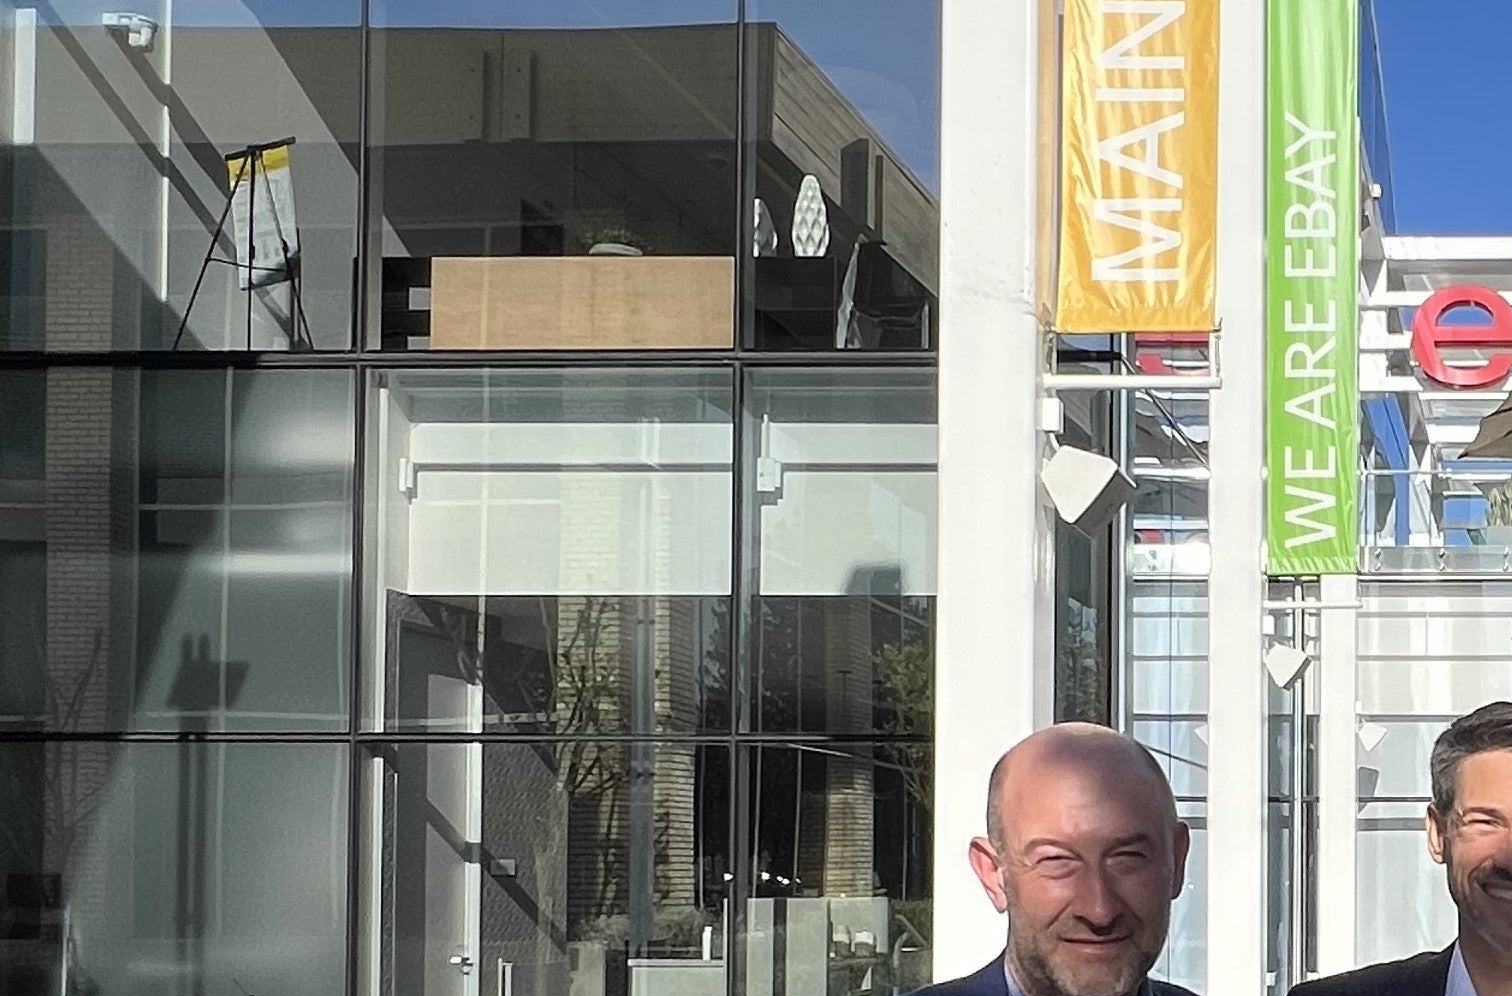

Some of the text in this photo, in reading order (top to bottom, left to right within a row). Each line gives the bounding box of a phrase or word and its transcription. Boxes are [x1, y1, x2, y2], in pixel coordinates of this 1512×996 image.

[1091, 0, 1186, 281] MAIN
[1284, 110, 1336, 549] WE ARE EBAY
